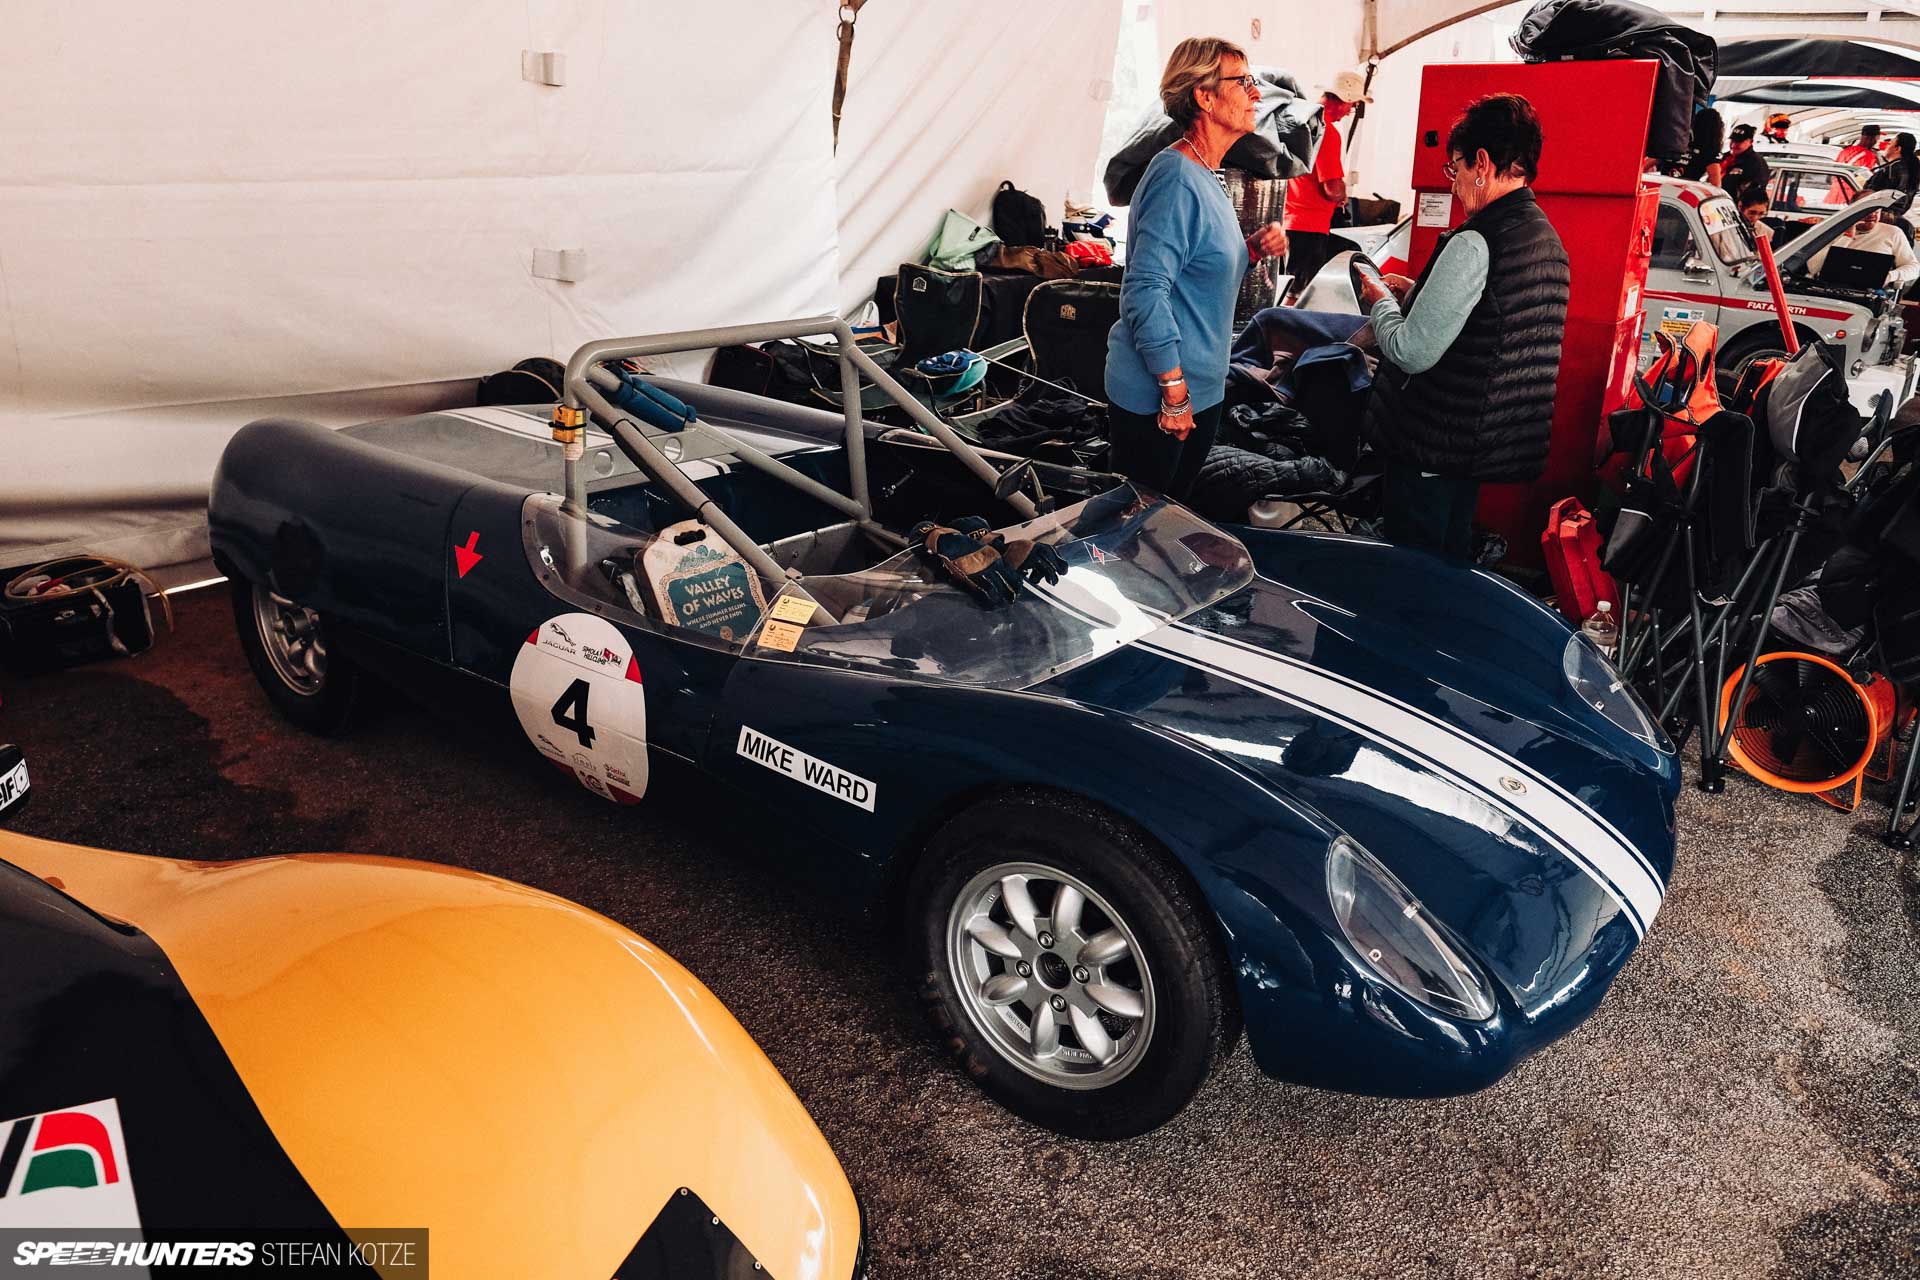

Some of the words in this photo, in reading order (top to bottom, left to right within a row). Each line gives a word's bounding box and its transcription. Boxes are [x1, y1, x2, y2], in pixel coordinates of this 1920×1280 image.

[1747, 301, 1767, 310] FIAT
[1767, 303, 1807, 315] ARTH
[684, 574, 730, 597] VALLEY
[682, 599, 700, 615] OF
[702, 586, 745, 608] WAVES
[542, 640, 577, 655] JAGUAR
[551, 678, 596, 750] 4
[742, 732, 794, 773] MIKE
[804, 758, 869, 804] WARD
